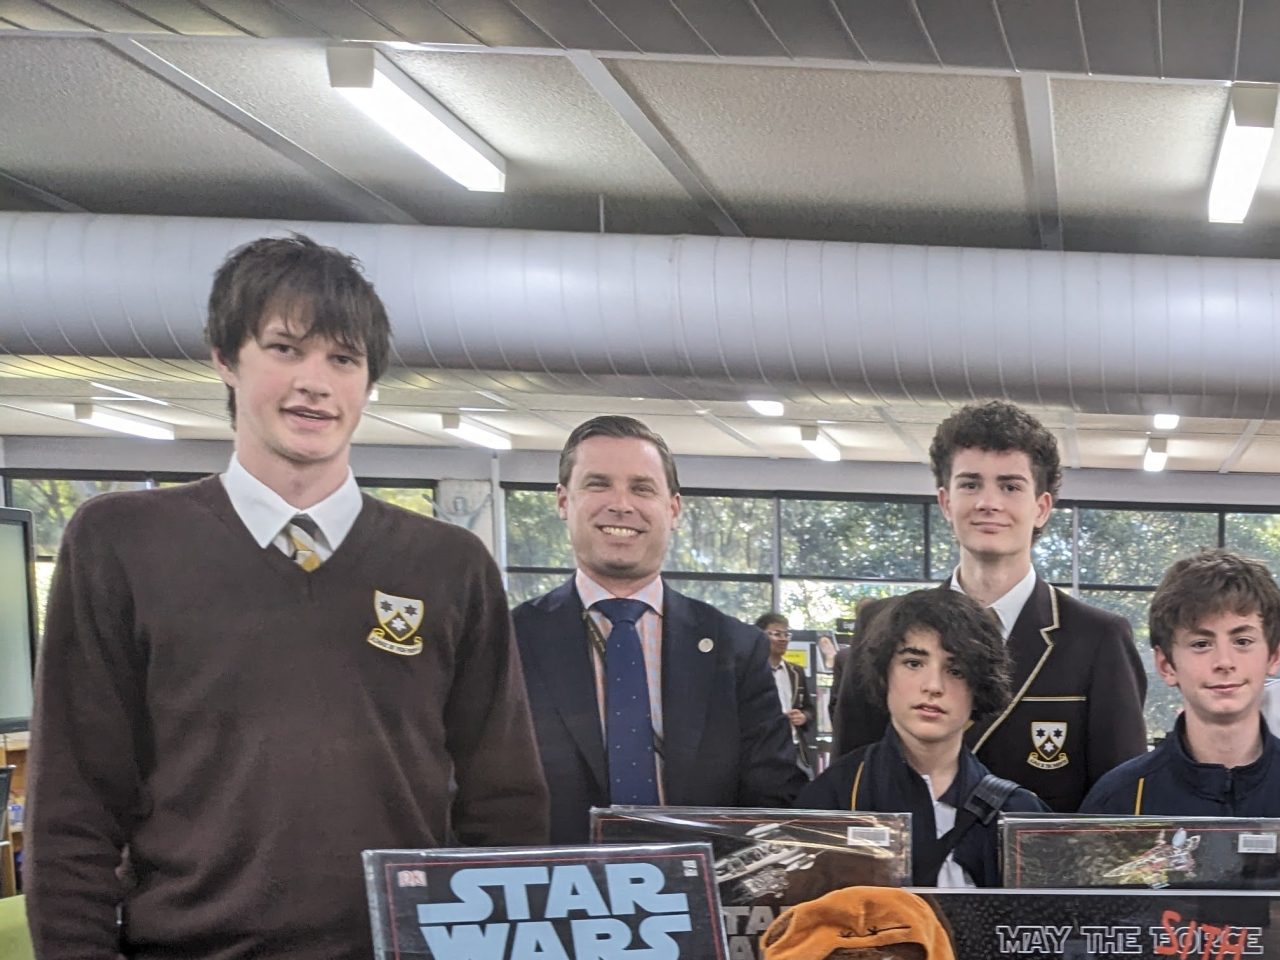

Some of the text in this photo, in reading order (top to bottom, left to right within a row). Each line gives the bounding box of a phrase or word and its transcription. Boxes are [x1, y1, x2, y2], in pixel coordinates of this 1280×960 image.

[416, 862, 690, 924] STAR
[722, 905, 793, 935] TA
[996, 925, 1072, 954] MAY
[1081, 925, 1142, 954] THE
